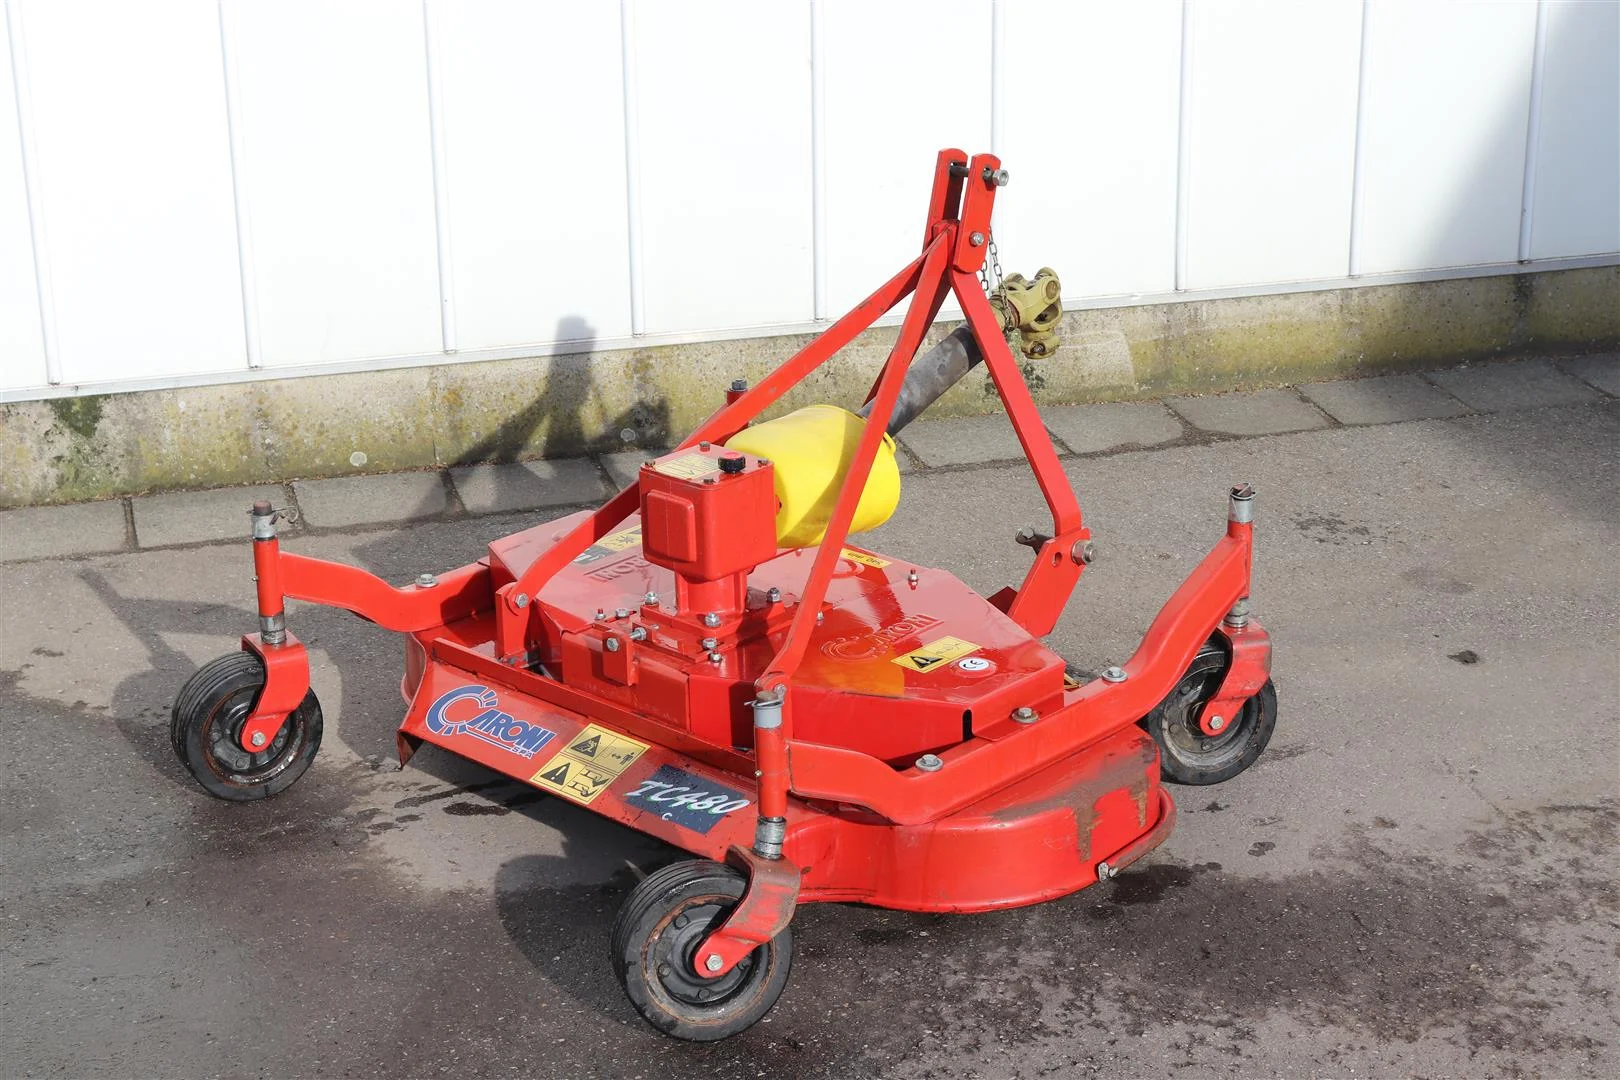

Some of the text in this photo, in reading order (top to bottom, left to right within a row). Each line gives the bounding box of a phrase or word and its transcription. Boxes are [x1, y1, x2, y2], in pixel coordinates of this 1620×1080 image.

[425, 684, 557, 755] CARONI
[511, 745, 535, 759] SPA
[623, 780, 751, 815] TC480
